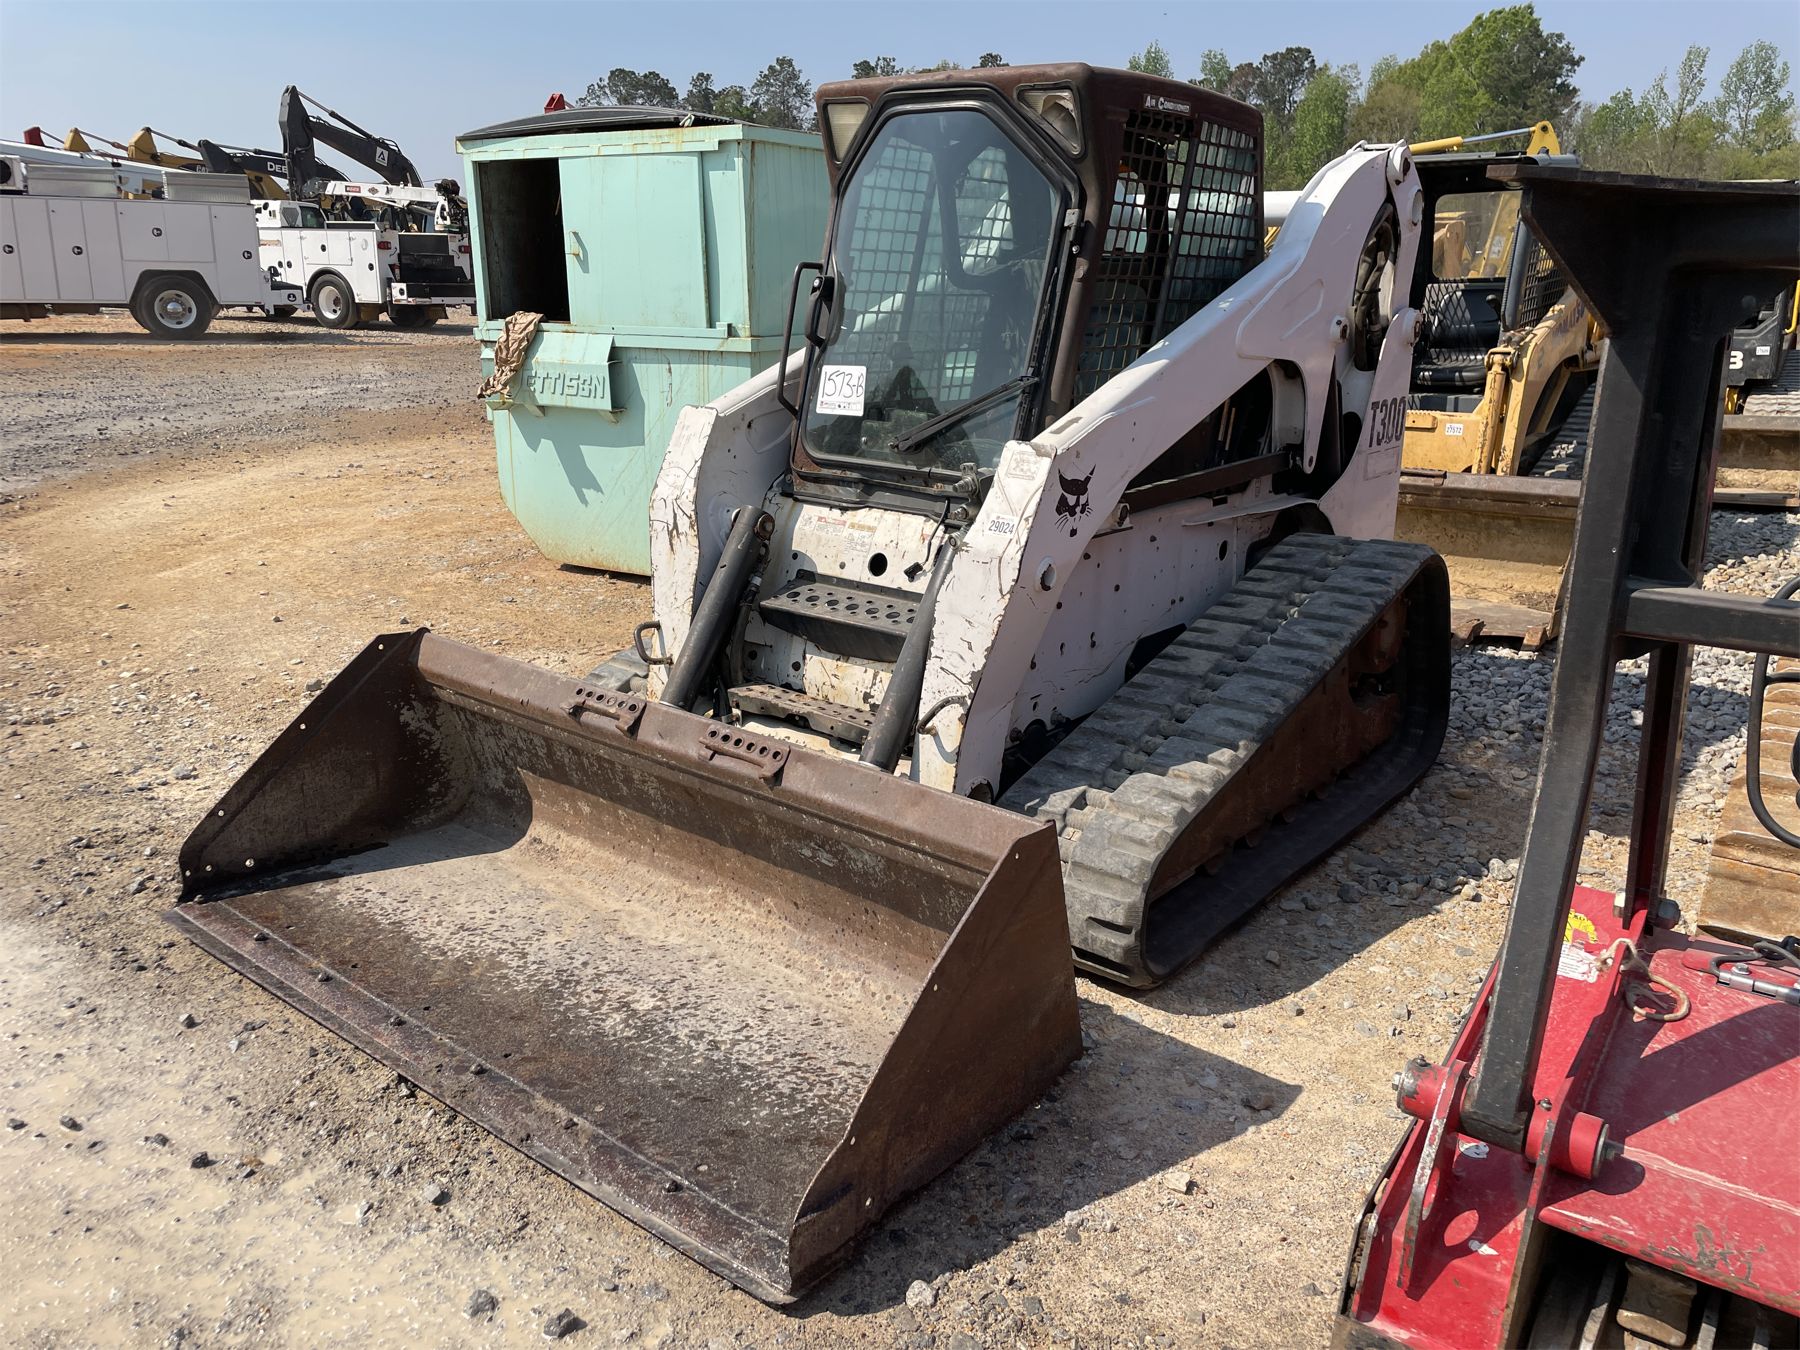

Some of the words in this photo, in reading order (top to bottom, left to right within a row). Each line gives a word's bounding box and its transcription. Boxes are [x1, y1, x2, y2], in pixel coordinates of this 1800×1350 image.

[821, 369, 865, 399] 1573-B
[1369, 396, 1407, 447] T300
[988, 519, 1015, 535] 29024
